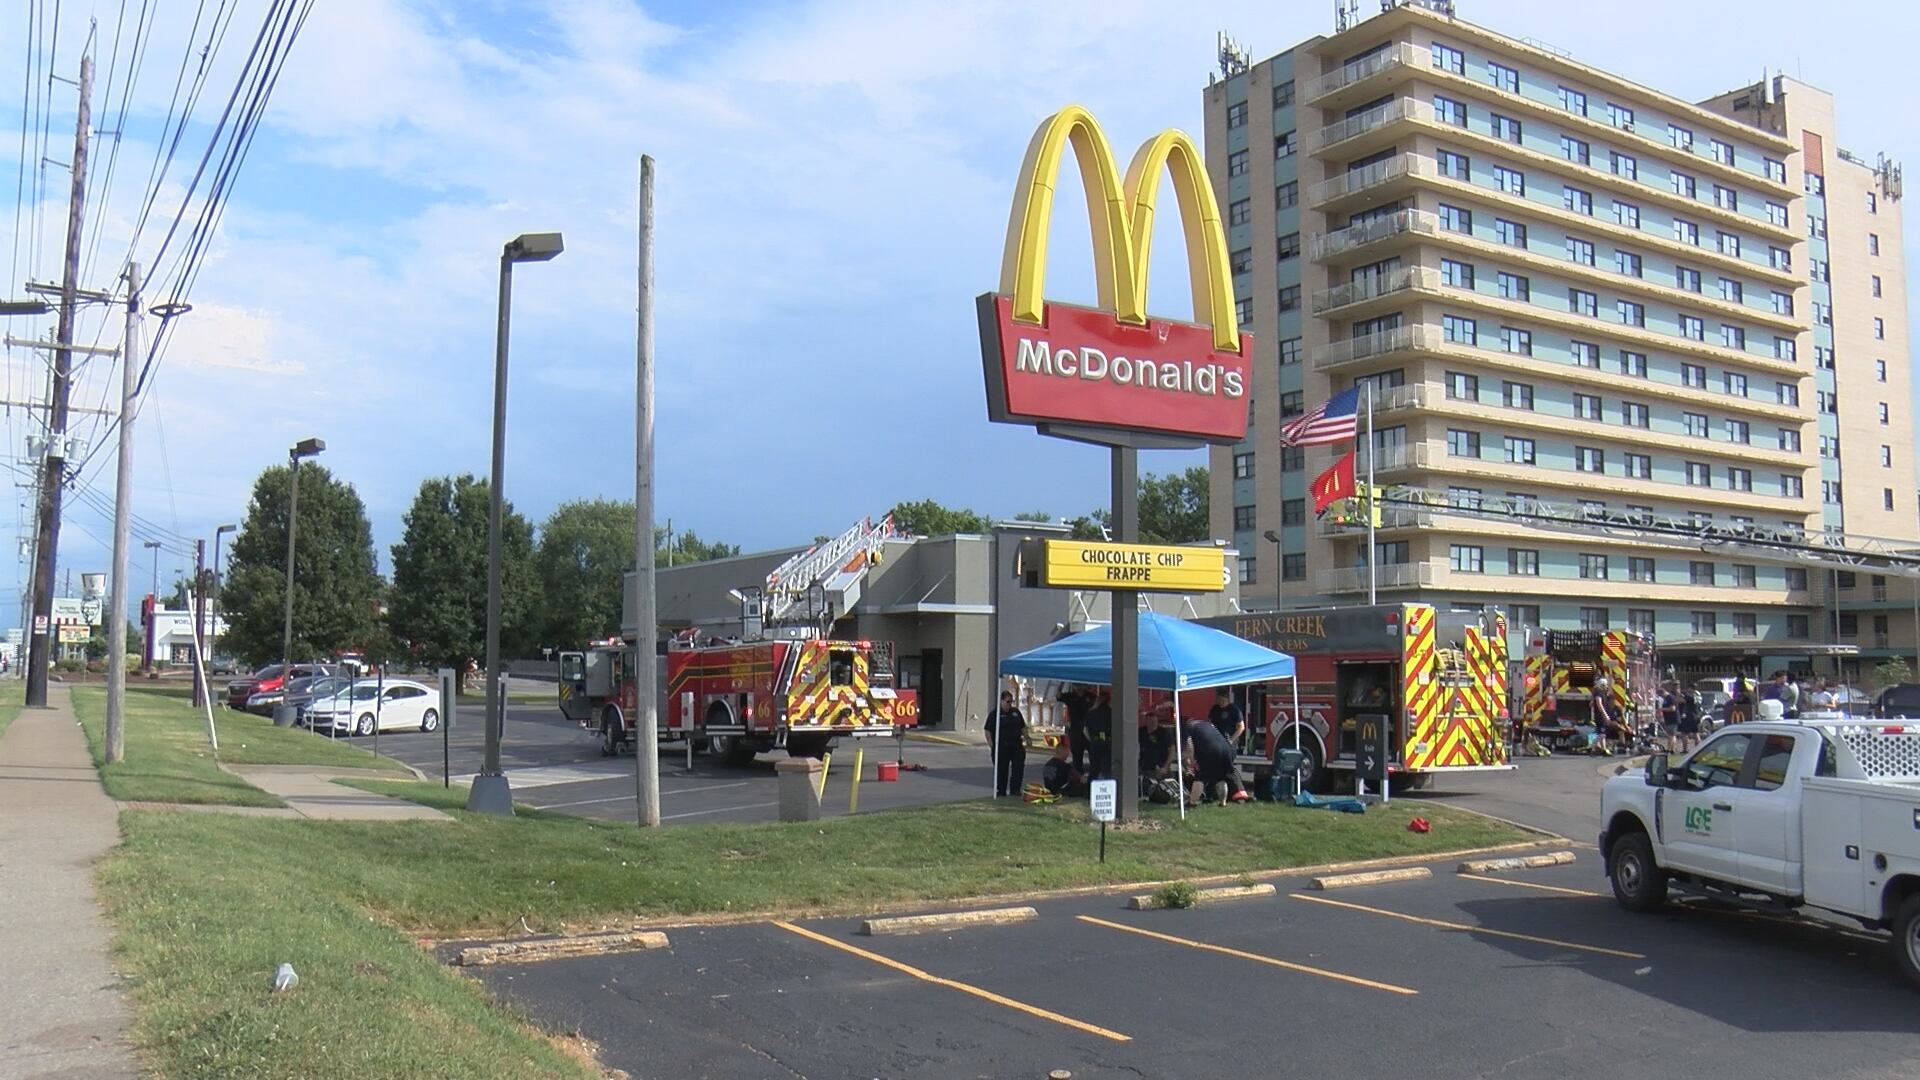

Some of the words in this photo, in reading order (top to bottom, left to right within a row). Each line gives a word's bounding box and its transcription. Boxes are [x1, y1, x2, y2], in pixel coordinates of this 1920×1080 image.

[1016, 338, 1244, 398] McDonald's
[1081, 549, 1151, 565] CHOCOLATE
[1157, 553, 1184, 567] CHIP
[1106, 567, 1152, 581] FRAPPE
[1235, 618, 1272, 640] FERN
[1275, 615, 1328, 638] CREEK
[757, 701, 770, 718] 66
[895, 699, 916, 717] 66
